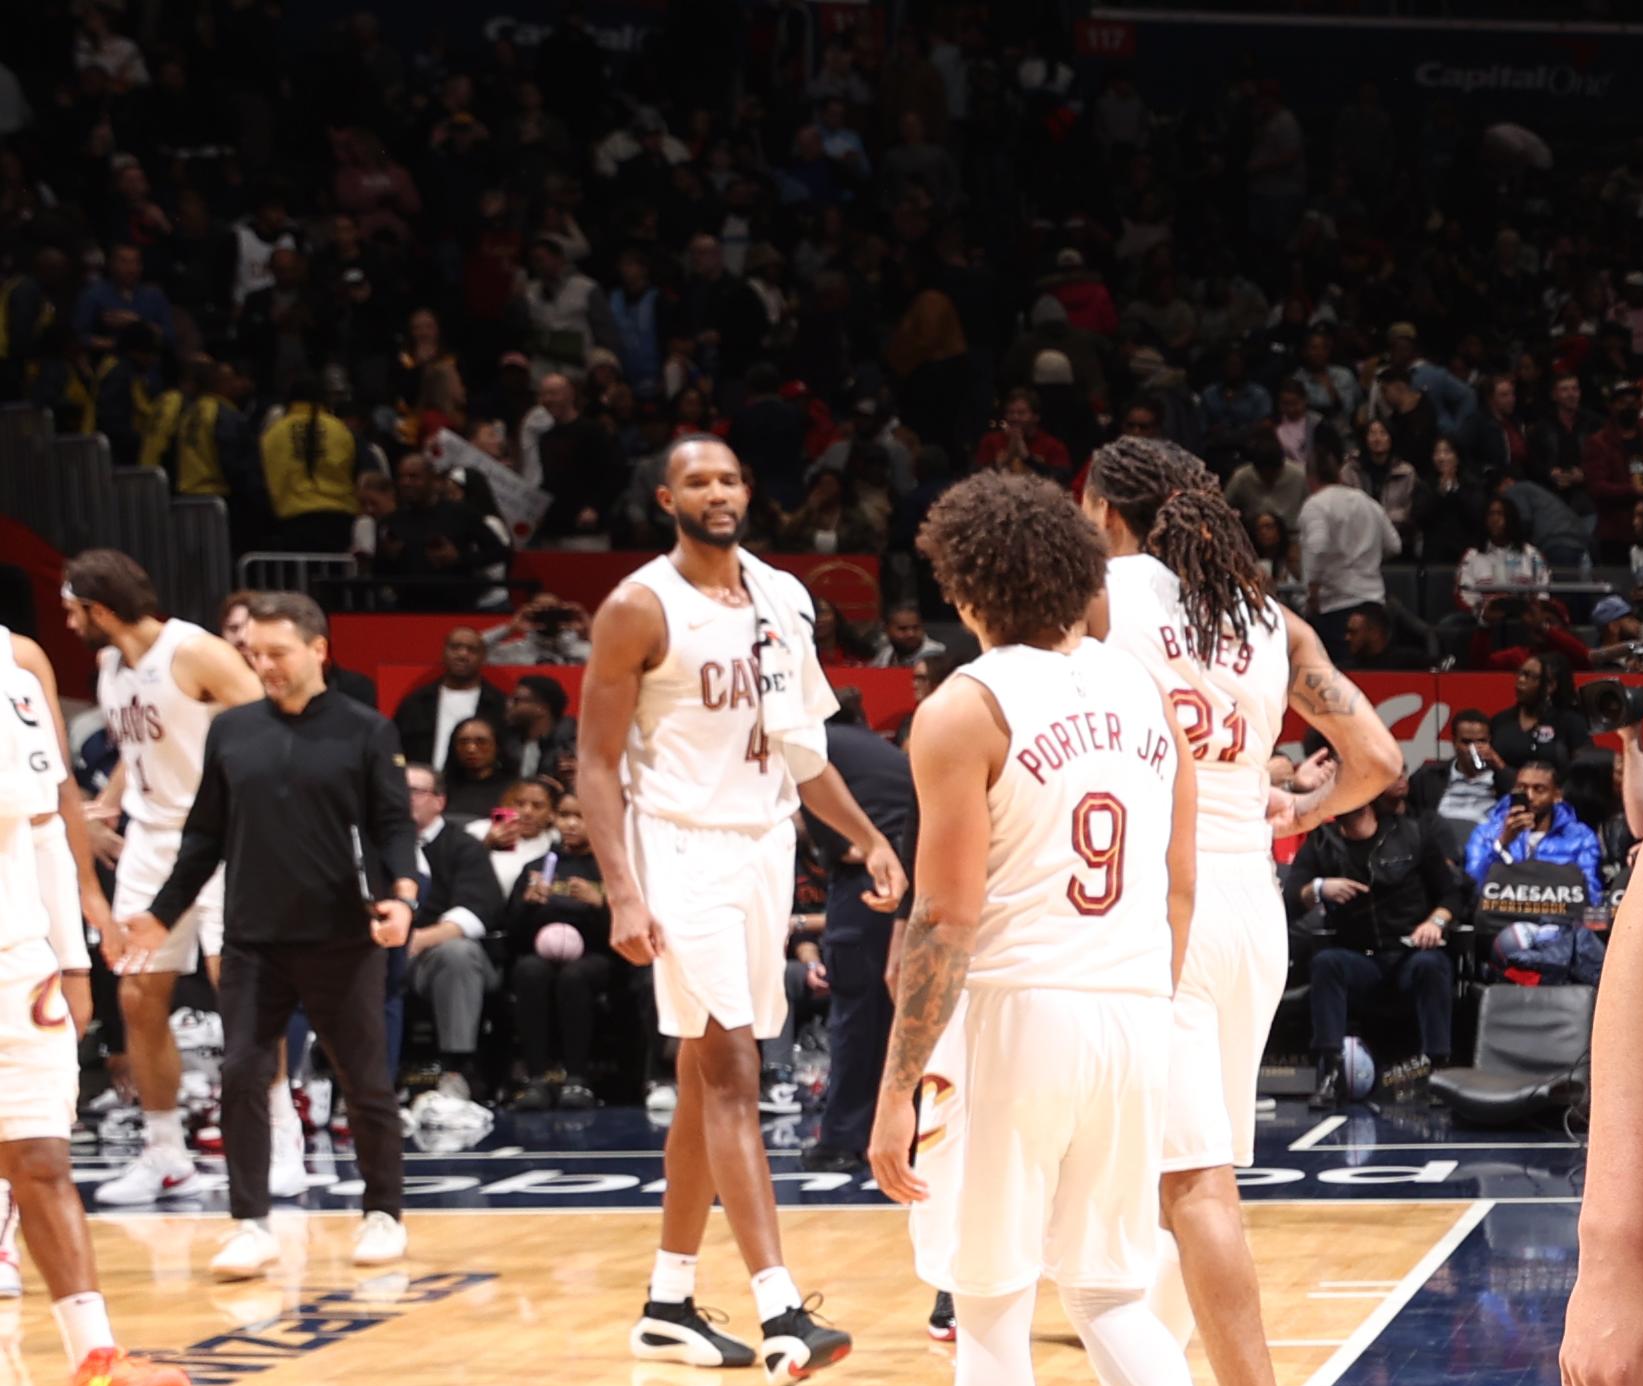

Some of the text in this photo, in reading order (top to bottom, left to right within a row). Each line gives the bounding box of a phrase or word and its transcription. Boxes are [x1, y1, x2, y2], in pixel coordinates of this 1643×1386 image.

[745, 723, 771, 774] 4
[1017, 711, 1122, 785] PORTER
[1066, 791, 1128, 917] 9
[1482, 881, 1585, 904] CAESARS
